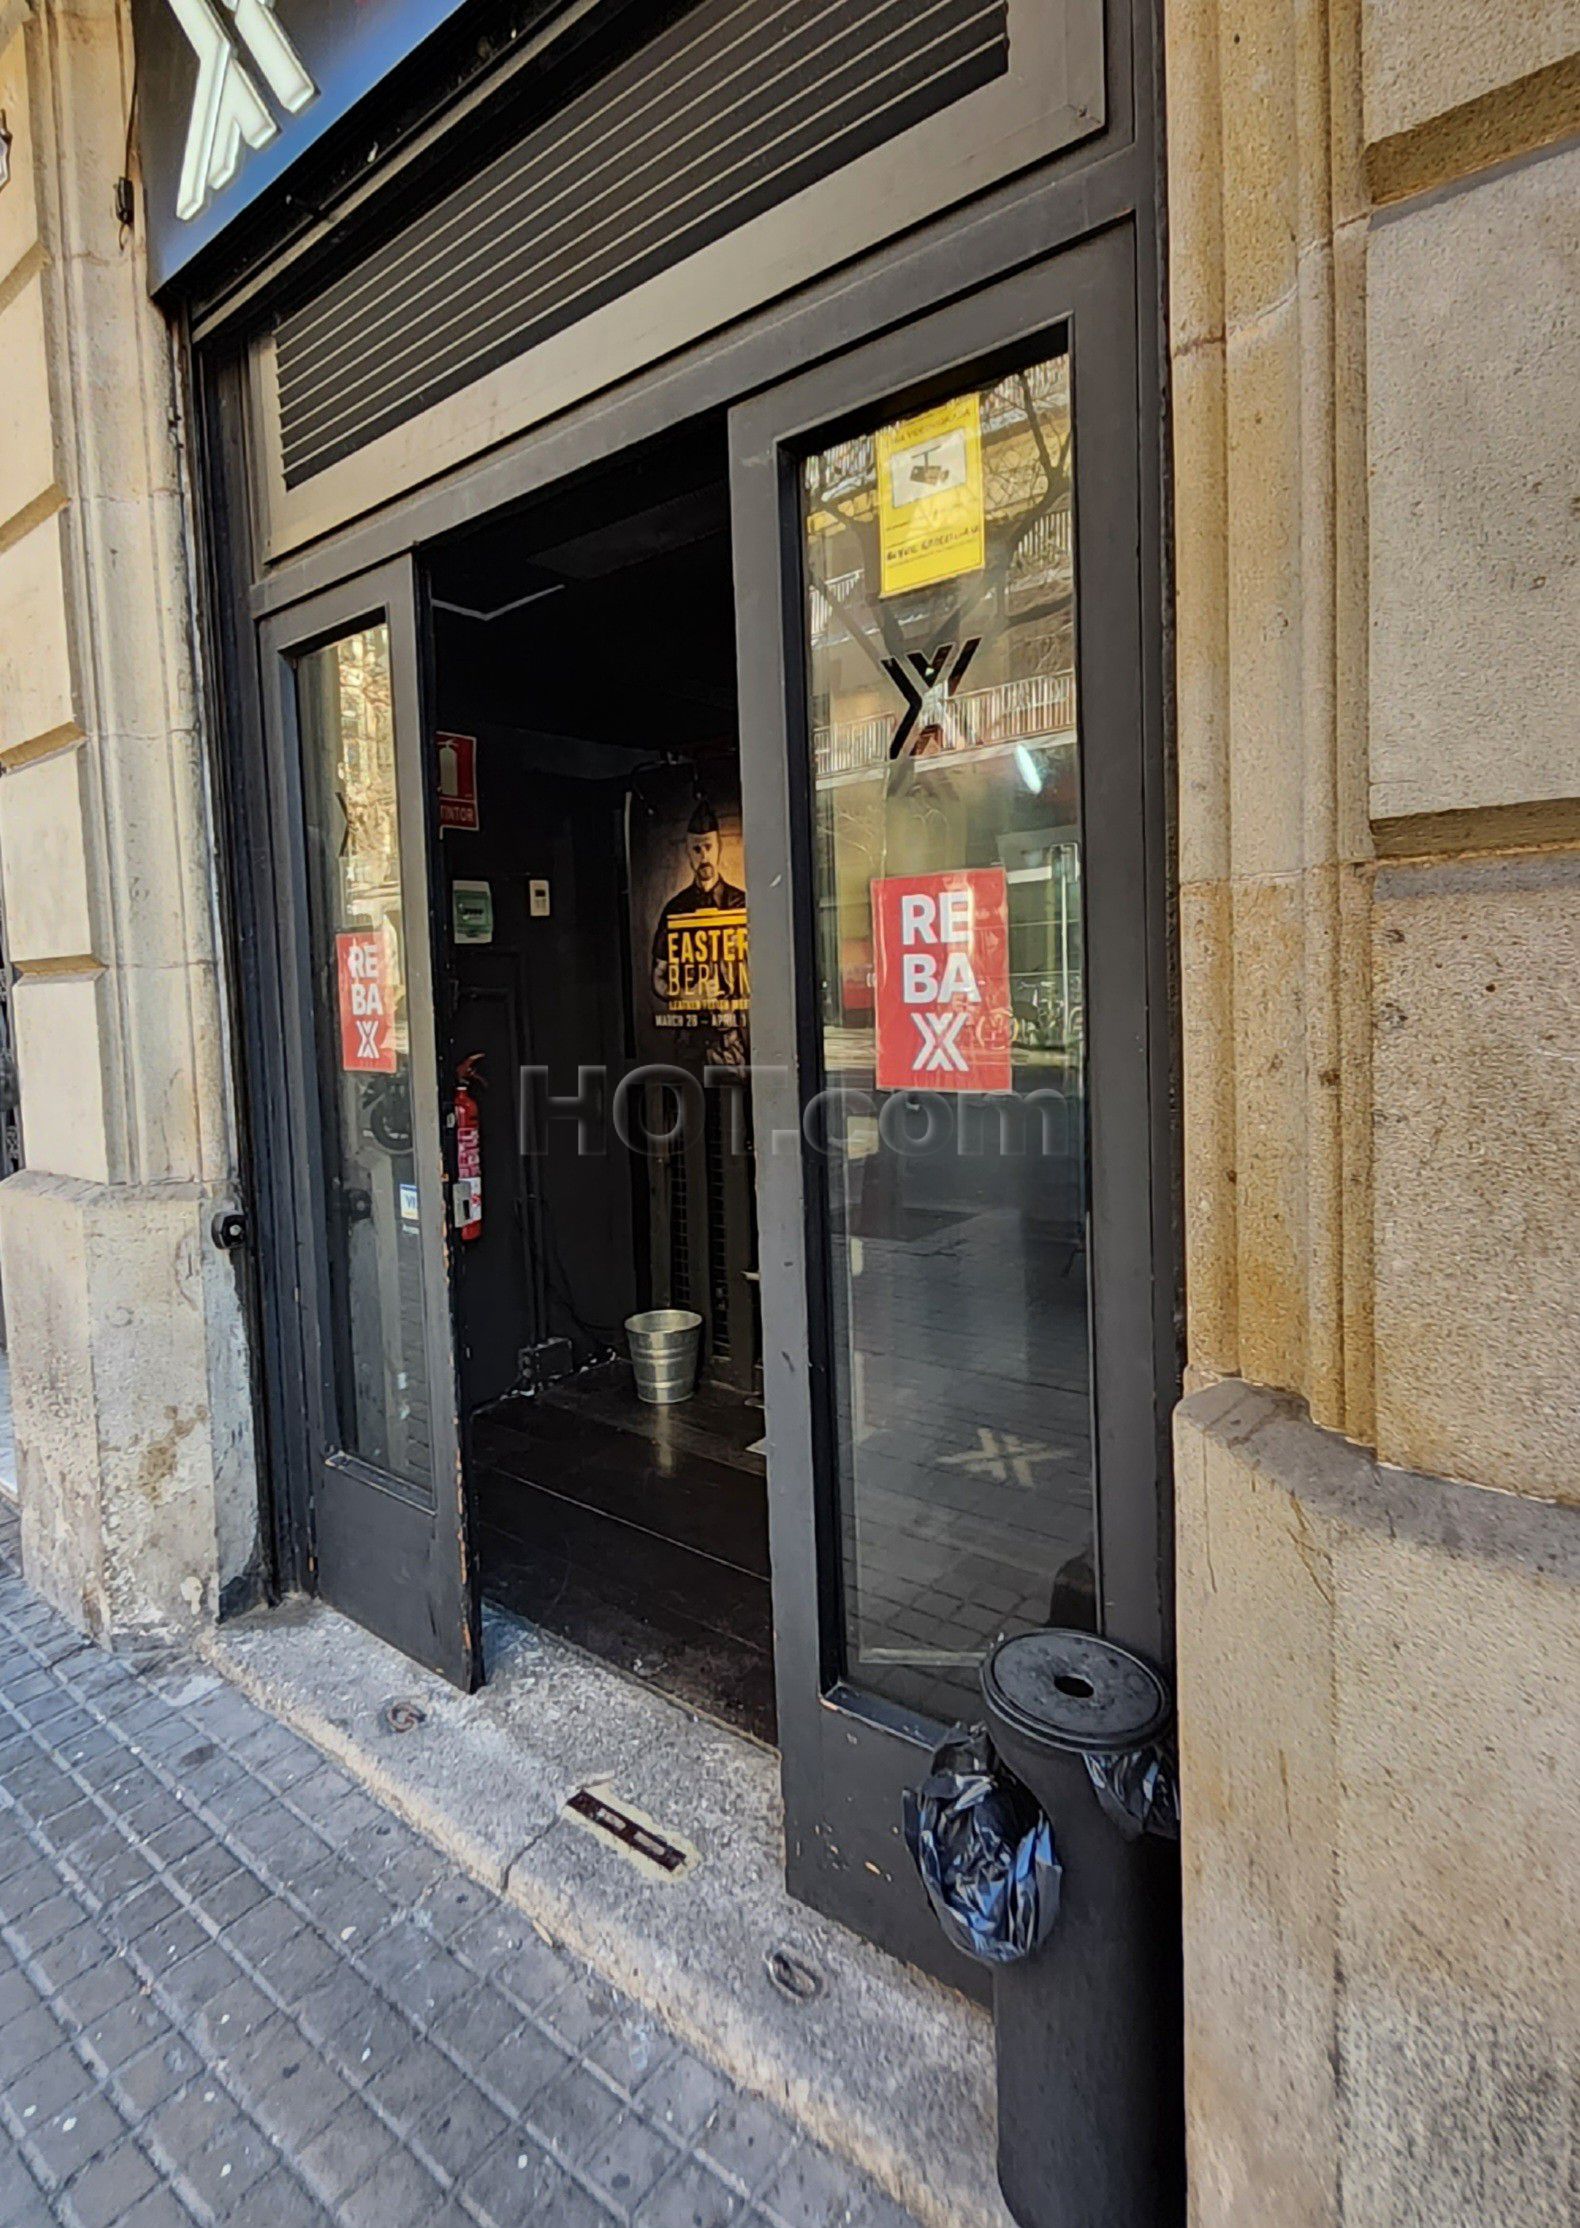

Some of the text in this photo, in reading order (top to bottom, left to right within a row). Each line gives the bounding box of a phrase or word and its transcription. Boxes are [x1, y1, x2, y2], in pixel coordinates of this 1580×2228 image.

[901, 891, 972, 946] RE
[348, 943, 379, 979] RE
[903, 952, 982, 1004] BA
[351, 983, 384, 1016] BA
